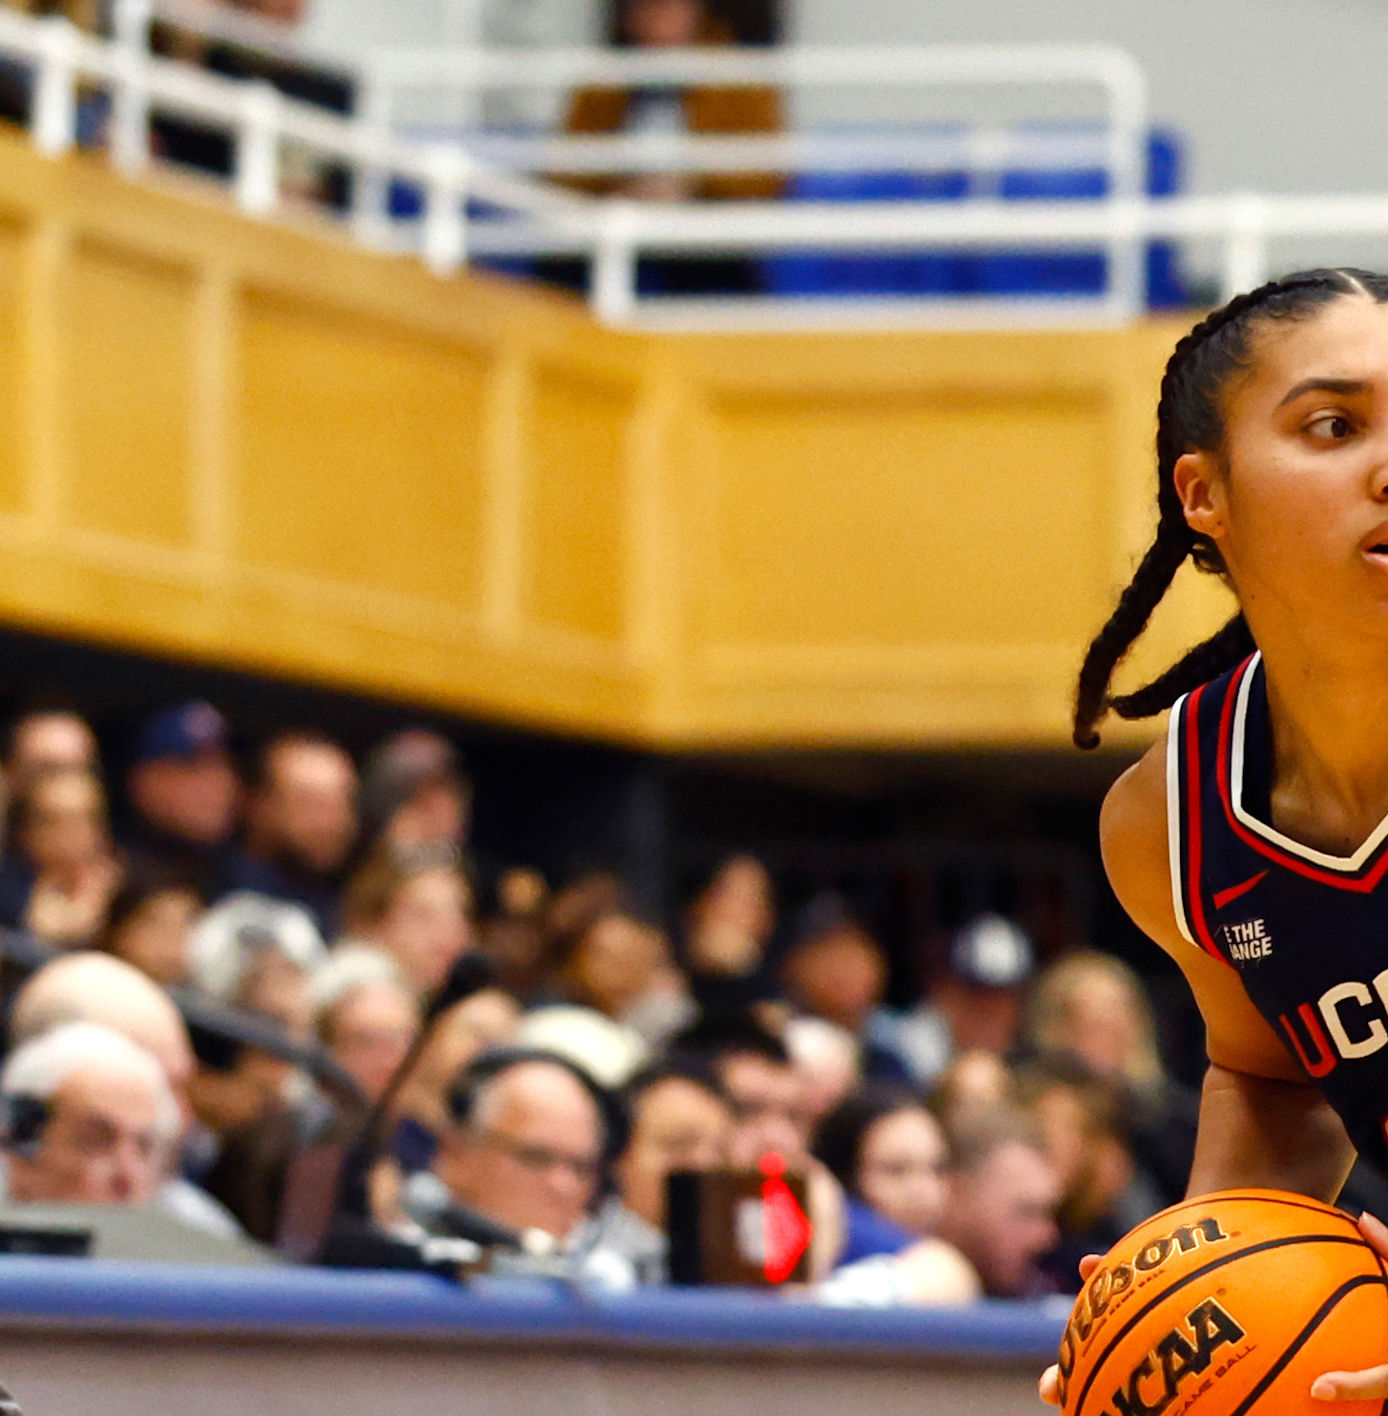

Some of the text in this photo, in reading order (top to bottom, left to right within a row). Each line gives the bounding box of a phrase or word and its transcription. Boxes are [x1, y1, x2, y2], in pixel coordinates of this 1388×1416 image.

[1230, 918, 1266, 943] THE
[1228, 936, 1273, 961] ANGE
[1215, 1344, 1258, 1378] BALL
